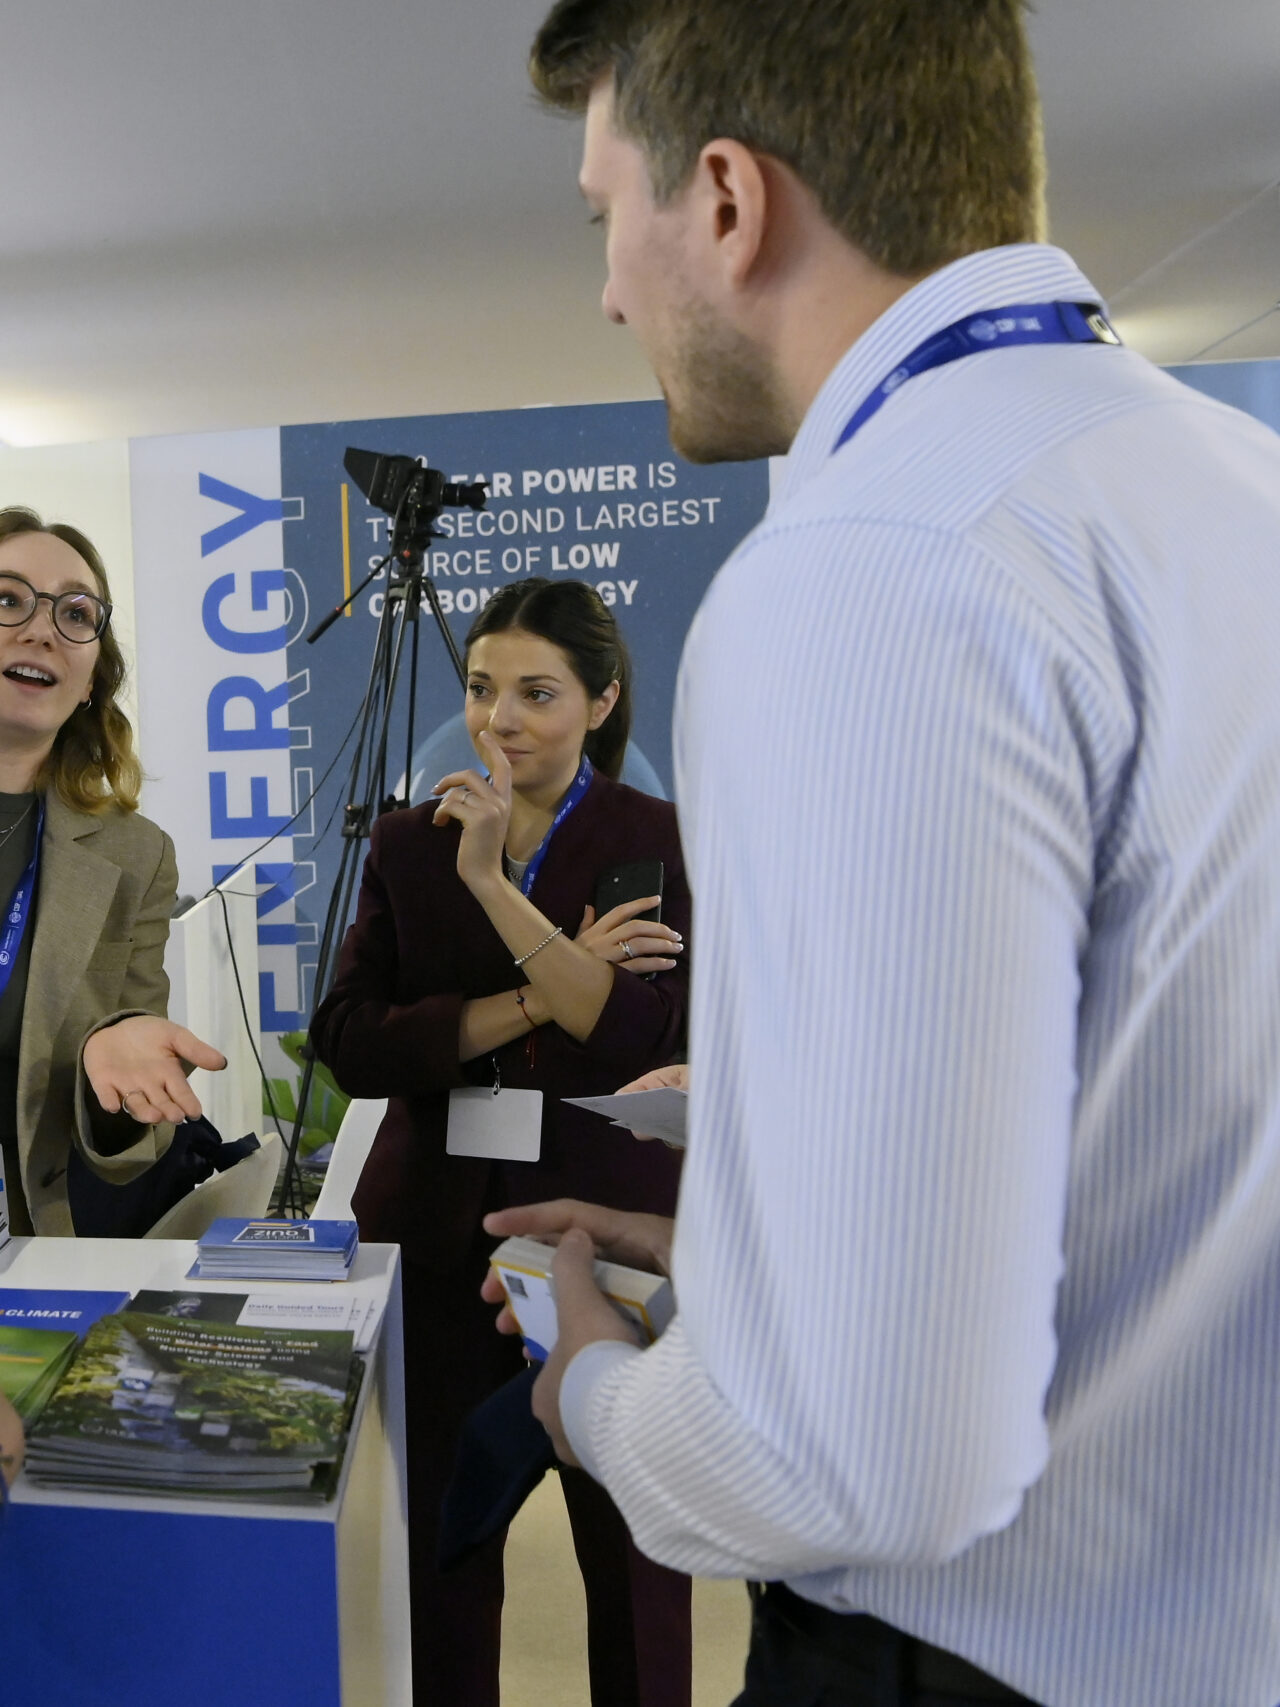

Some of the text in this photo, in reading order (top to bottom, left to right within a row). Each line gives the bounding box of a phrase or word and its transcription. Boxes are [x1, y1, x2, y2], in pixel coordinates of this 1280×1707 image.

[522, 465, 637, 496] POWER
[648, 462, 677, 489] IS
[436, 507, 565, 539] SECOND
[575, 498, 721, 532] LARGEST
[501, 546, 542, 574] OF
[551, 543, 621, 571] LOW
[198, 472, 319, 1035] ENERGY
